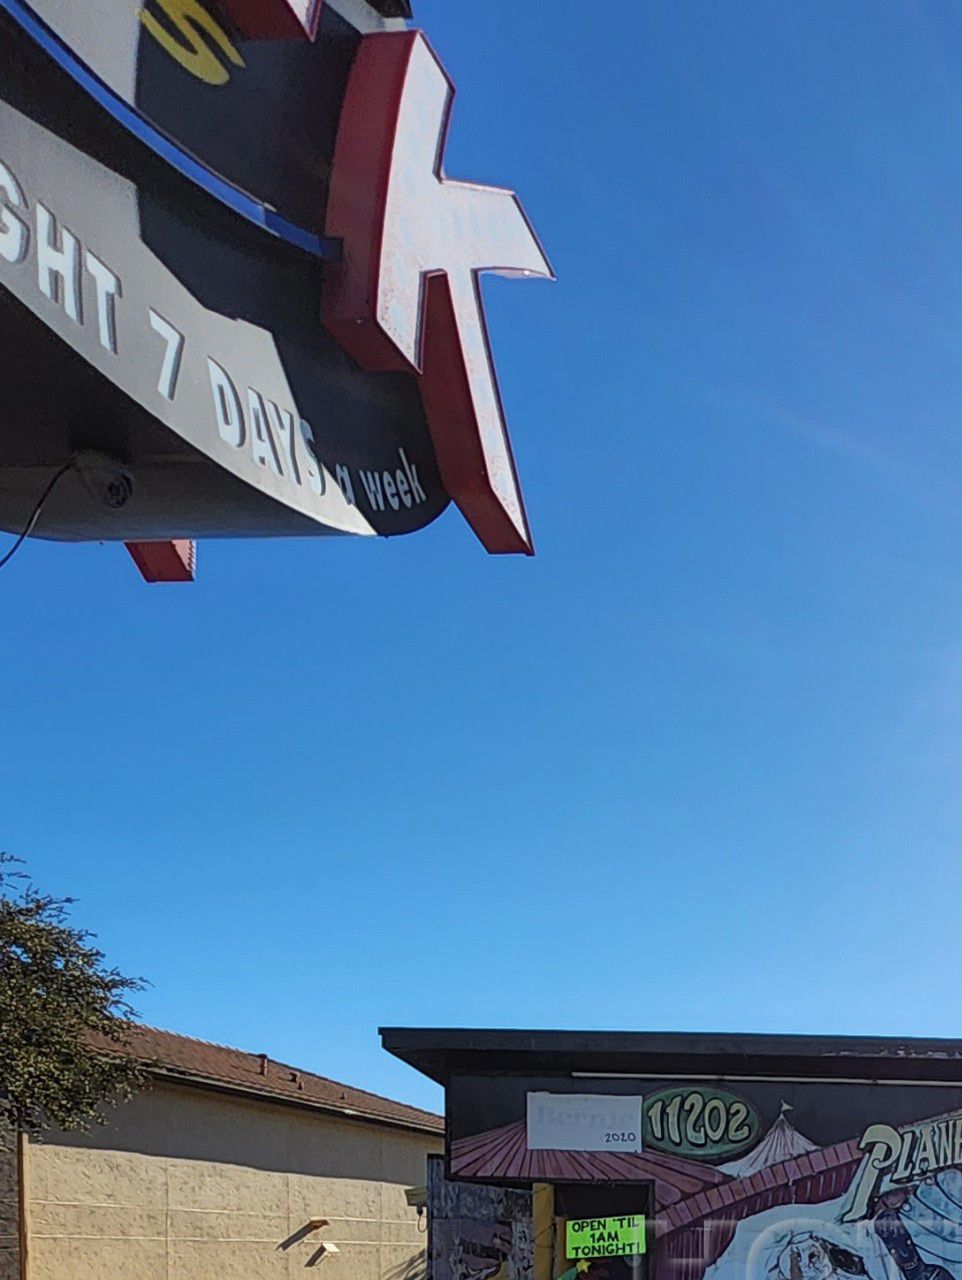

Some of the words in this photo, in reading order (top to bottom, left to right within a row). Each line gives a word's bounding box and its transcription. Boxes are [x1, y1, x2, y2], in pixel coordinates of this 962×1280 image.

[149, 305, 185, 401] 7
[208, 356, 326, 497] DAYS
[335, 463, 355, 506] a
[359, 448, 427, 512] week
[648, 1091, 752, 1148] 11202
[604, 1131, 637, 1144] 2020
[571, 1219, 607, 1233] OPEN
[589, 1230, 620, 1243] 1AM
[571, 1242, 640, 1257] TONIGHT!
